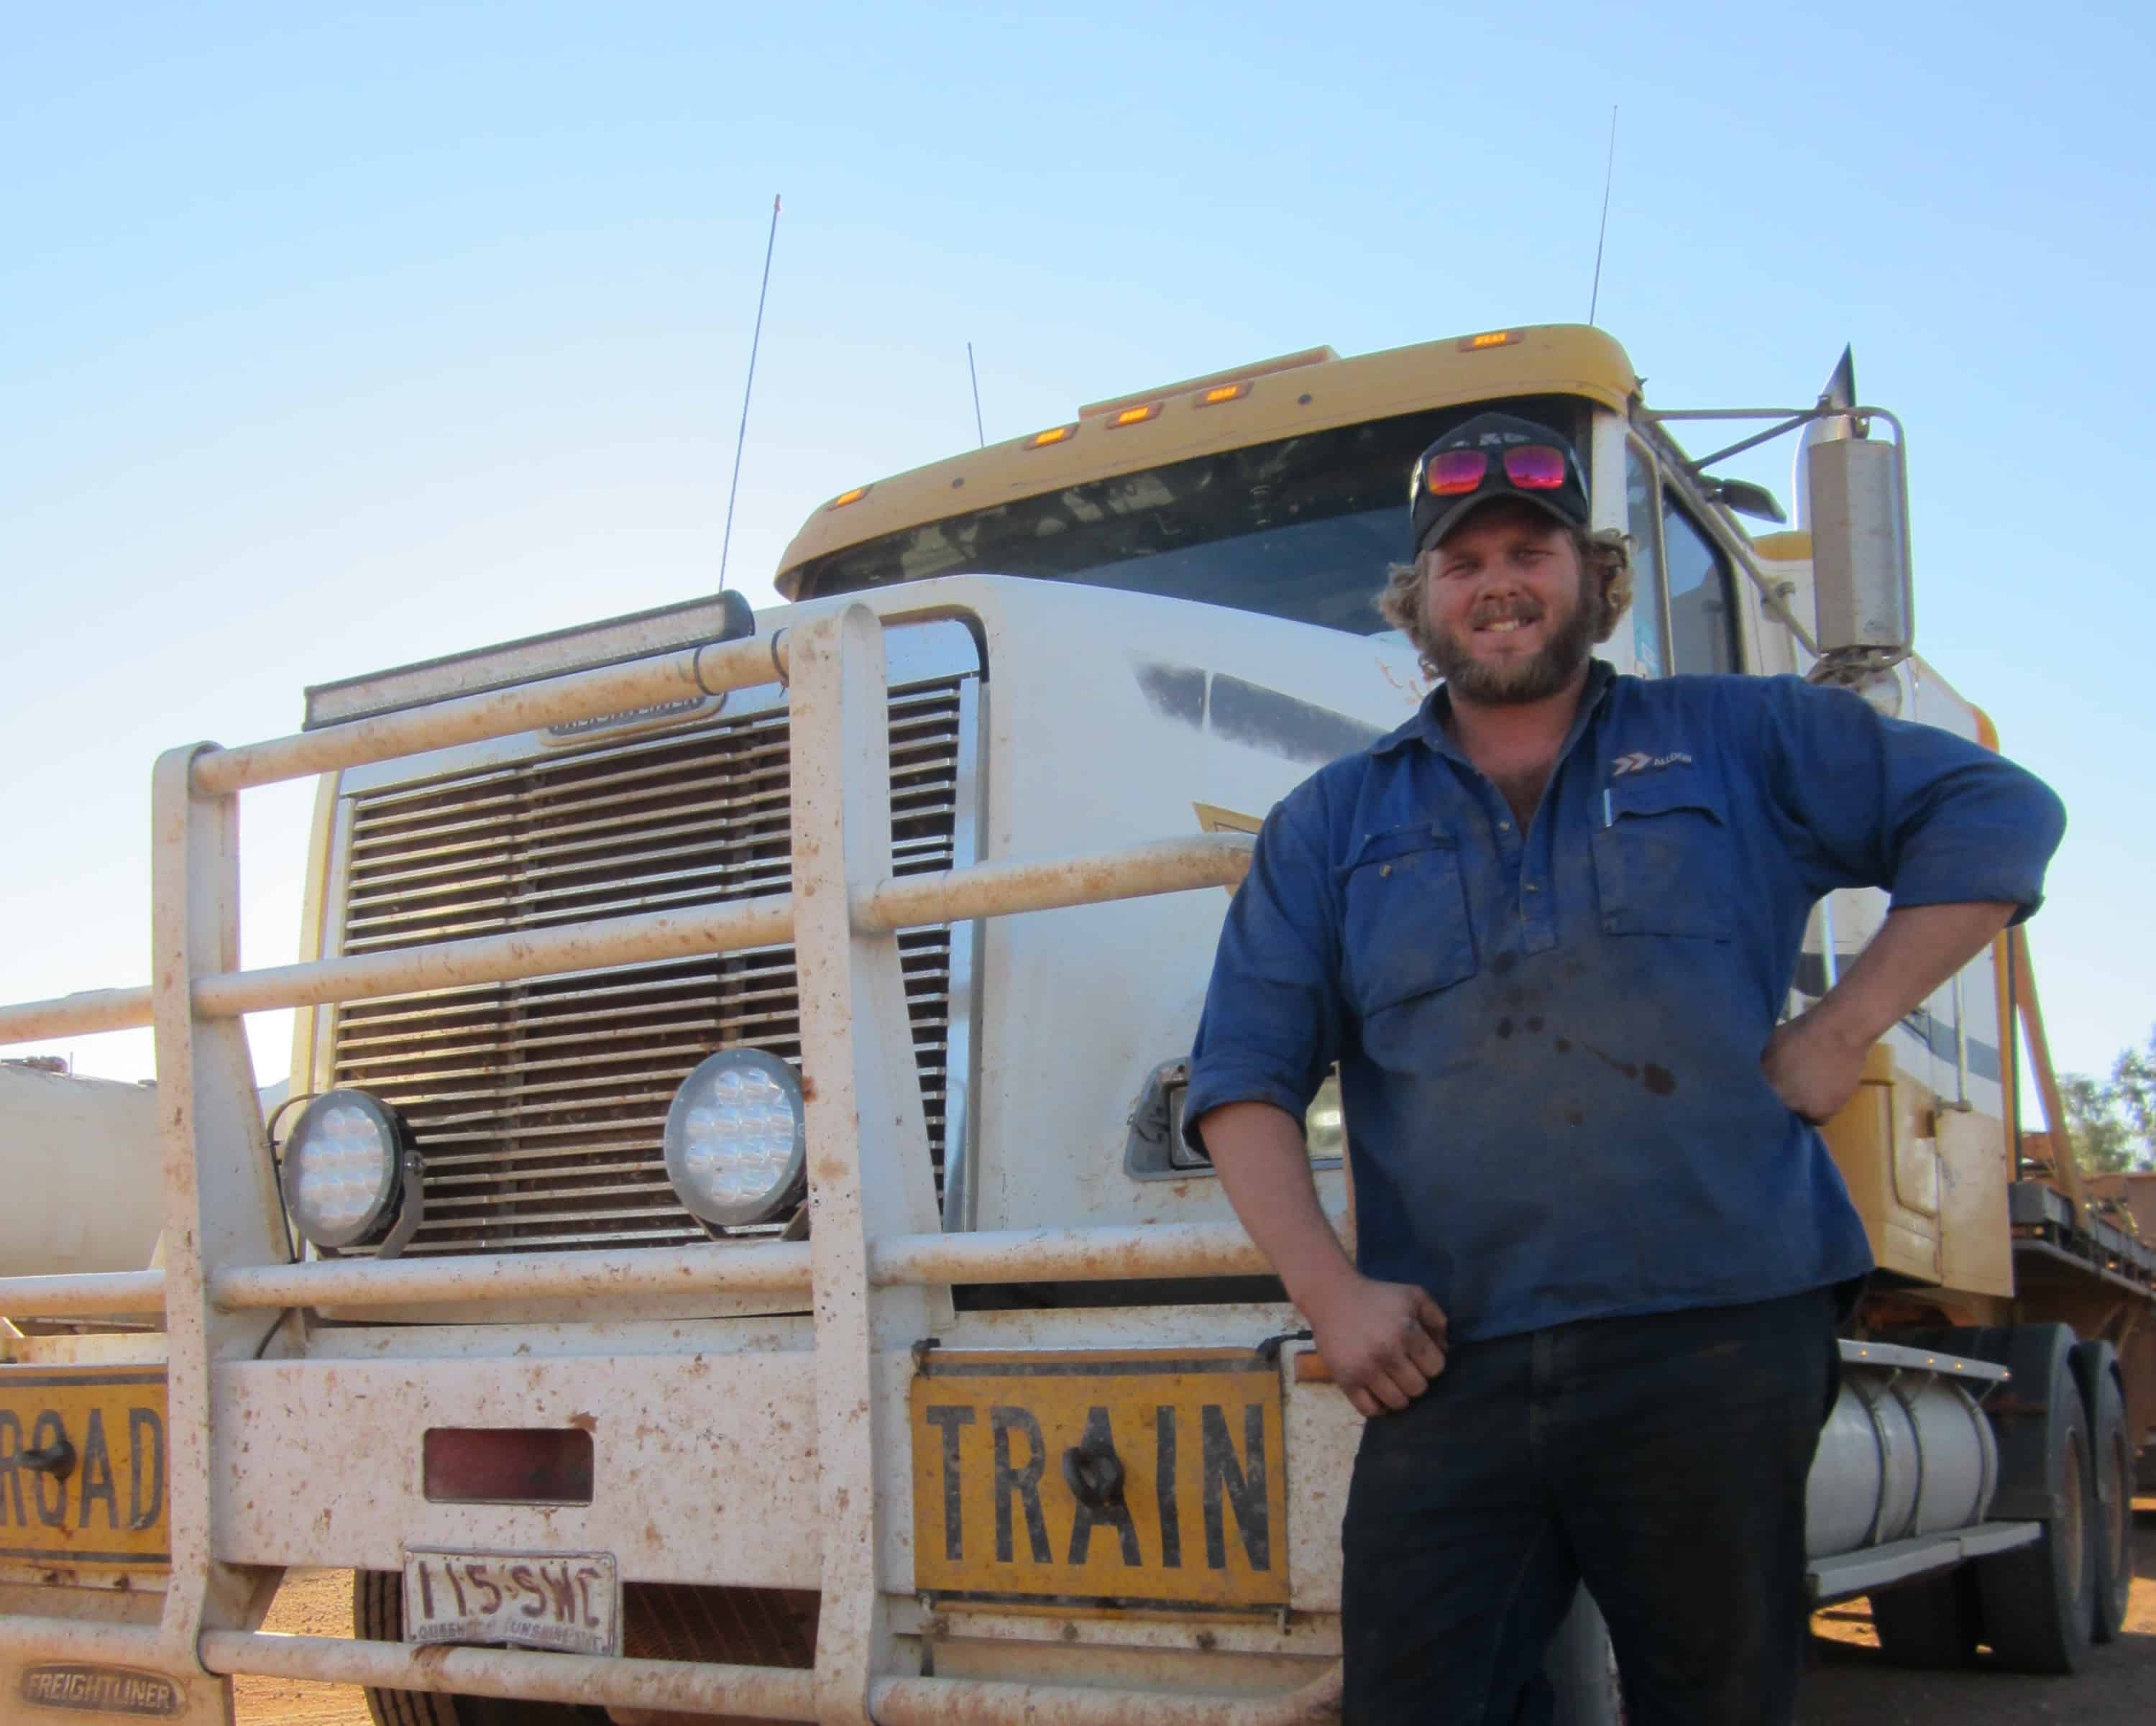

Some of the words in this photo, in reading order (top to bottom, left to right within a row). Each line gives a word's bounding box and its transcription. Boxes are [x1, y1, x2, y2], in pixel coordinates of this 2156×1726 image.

[0, 1407, 164, 1530] ROAD
[926, 1405, 1271, 1571] TRAIN
[27, 1673, 170, 1709] FREIGHTLINER
